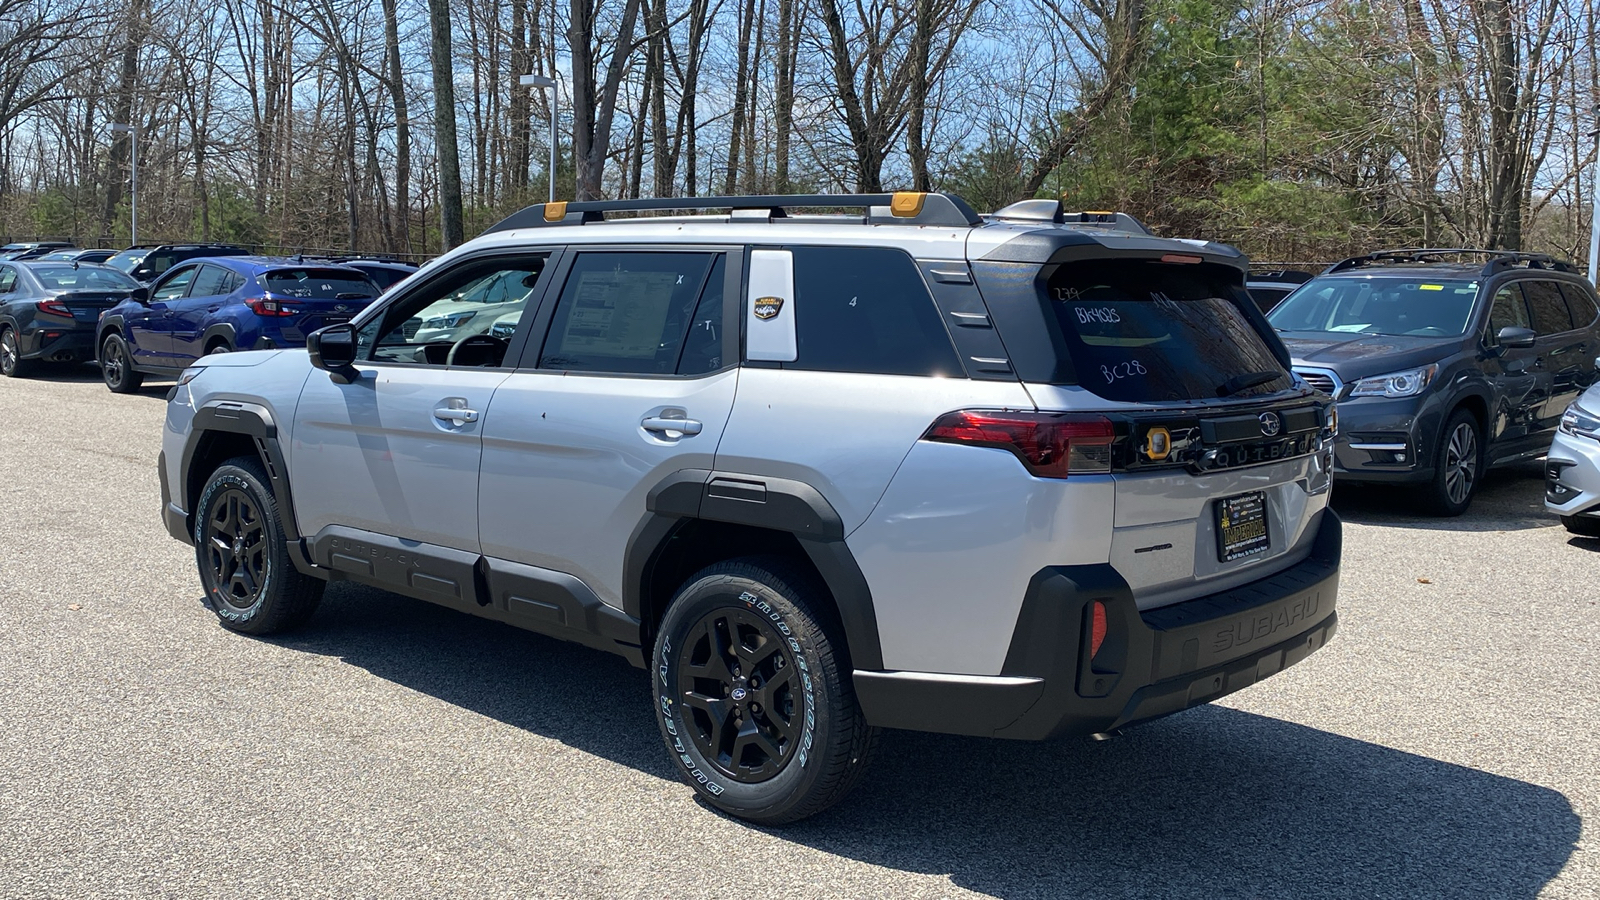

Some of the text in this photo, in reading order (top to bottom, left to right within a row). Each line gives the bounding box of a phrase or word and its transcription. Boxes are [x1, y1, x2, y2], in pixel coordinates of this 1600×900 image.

[848, 295, 858, 307] 4
[330, 538, 421, 568] OUTBACK
[1224, 519, 1266, 545] IMPERIAL
[1212, 591, 1320, 653] SUBARU
[738, 590, 815, 768] BRIDGESTONE
[658, 636, 725, 797] DUELER A/T
